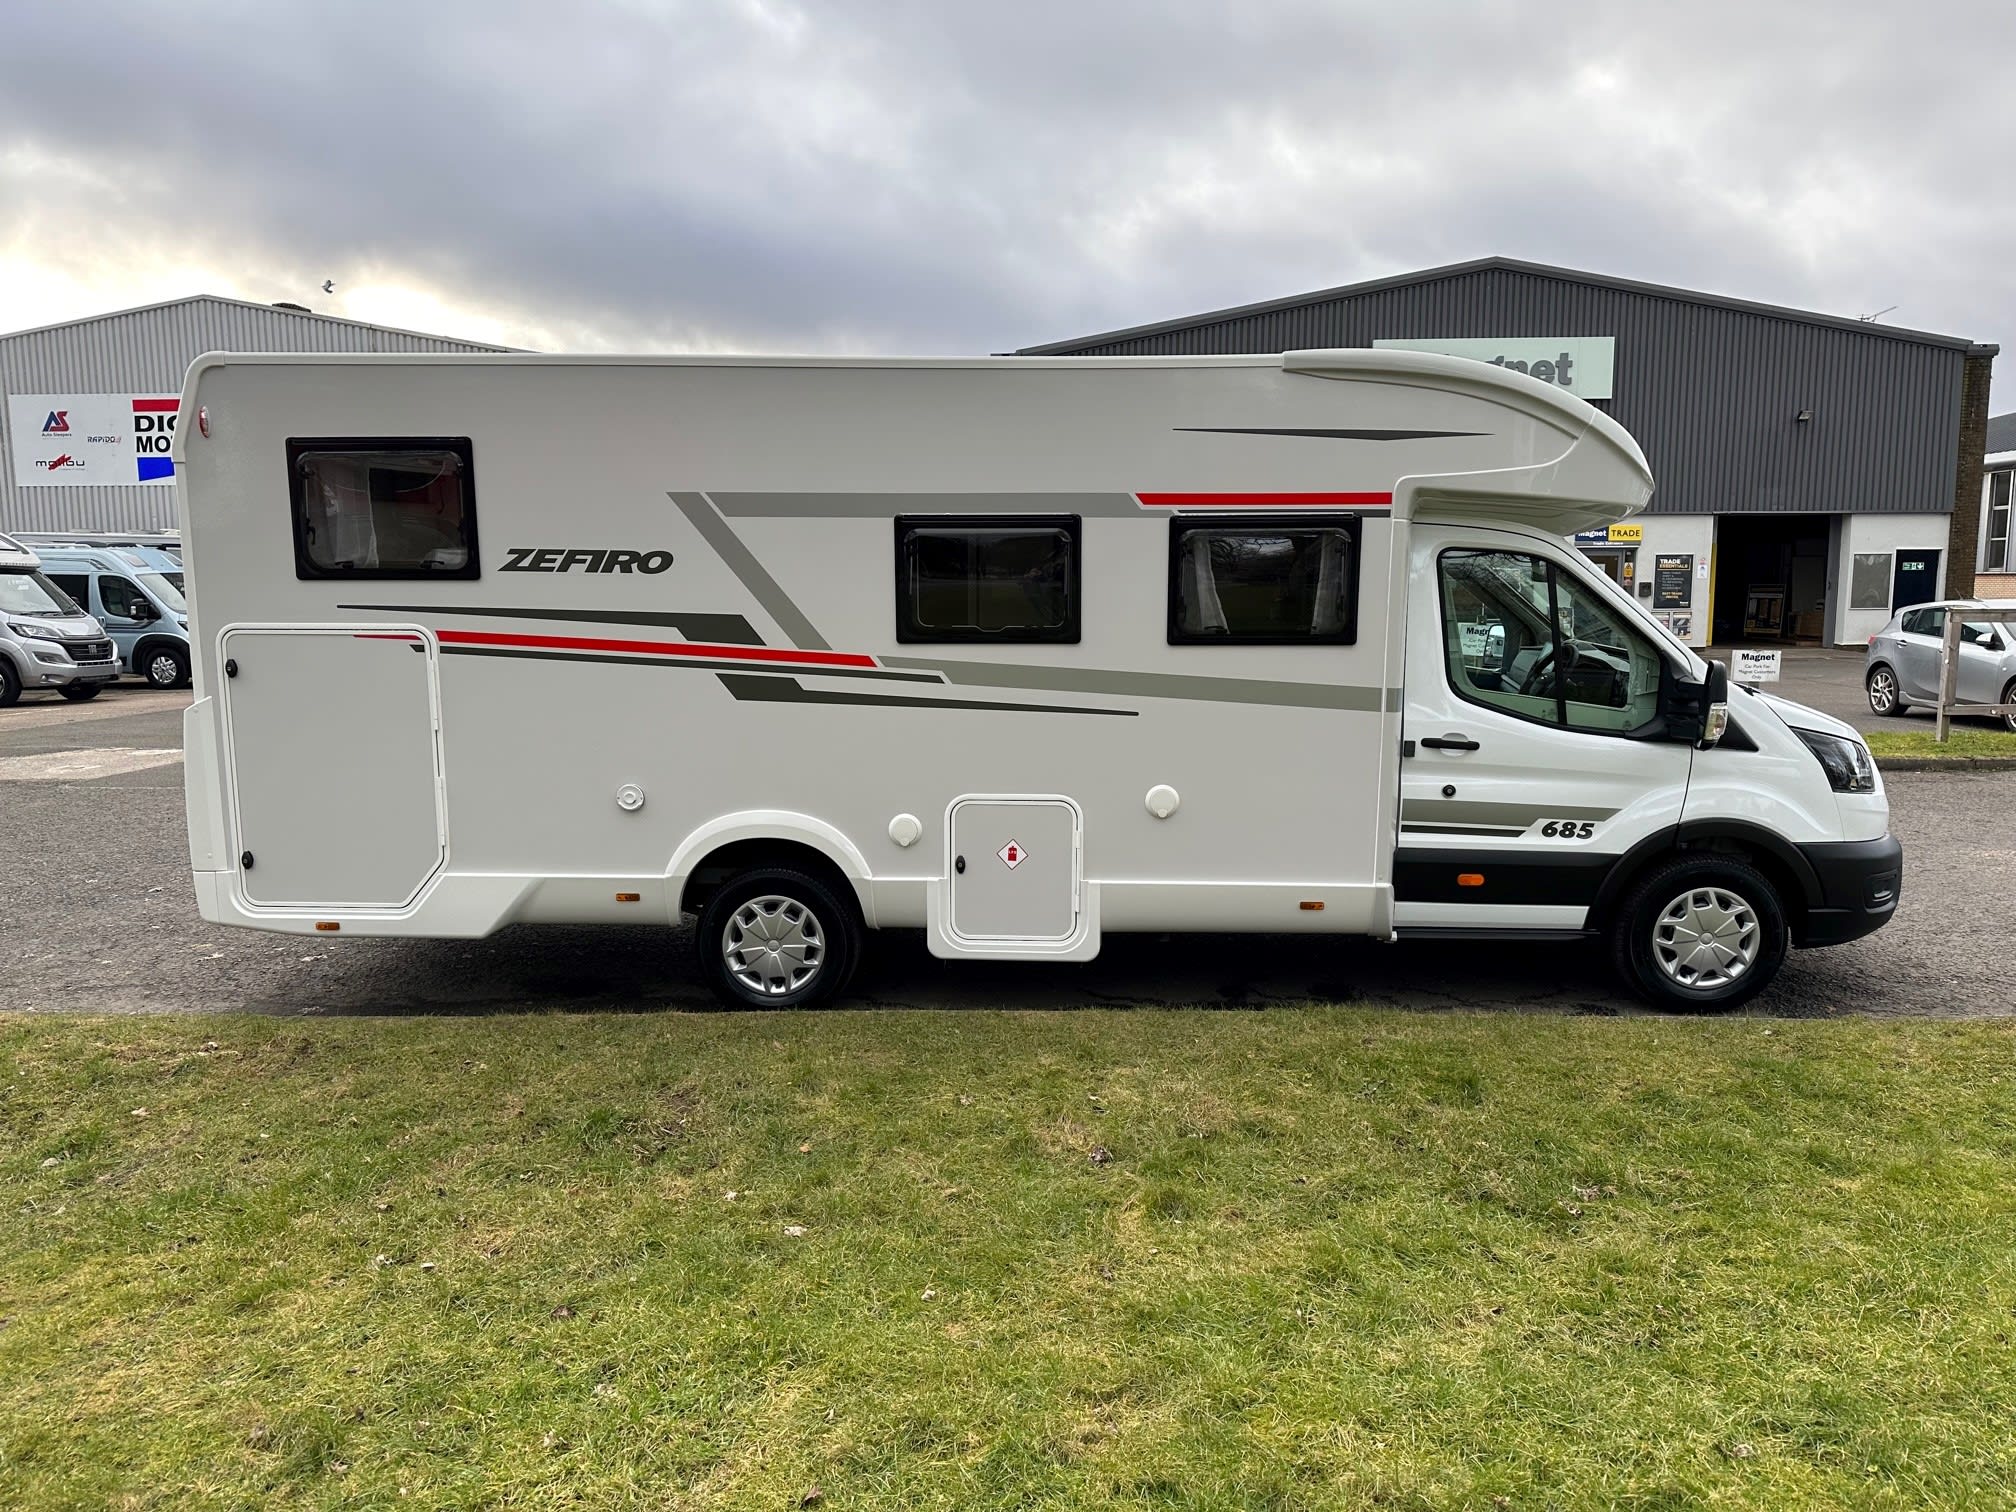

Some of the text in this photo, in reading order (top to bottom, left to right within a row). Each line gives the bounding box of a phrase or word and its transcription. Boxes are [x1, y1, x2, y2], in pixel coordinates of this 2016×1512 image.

[42, 410, 70, 432] AS
[136, 435, 173, 453] MO
[1611, 529, 1640, 537] TRADE
[497, 548, 674, 575] ZEFIRO
[1742, 654, 1775, 662] Magnet
[1541, 820, 1596, 840] 685
